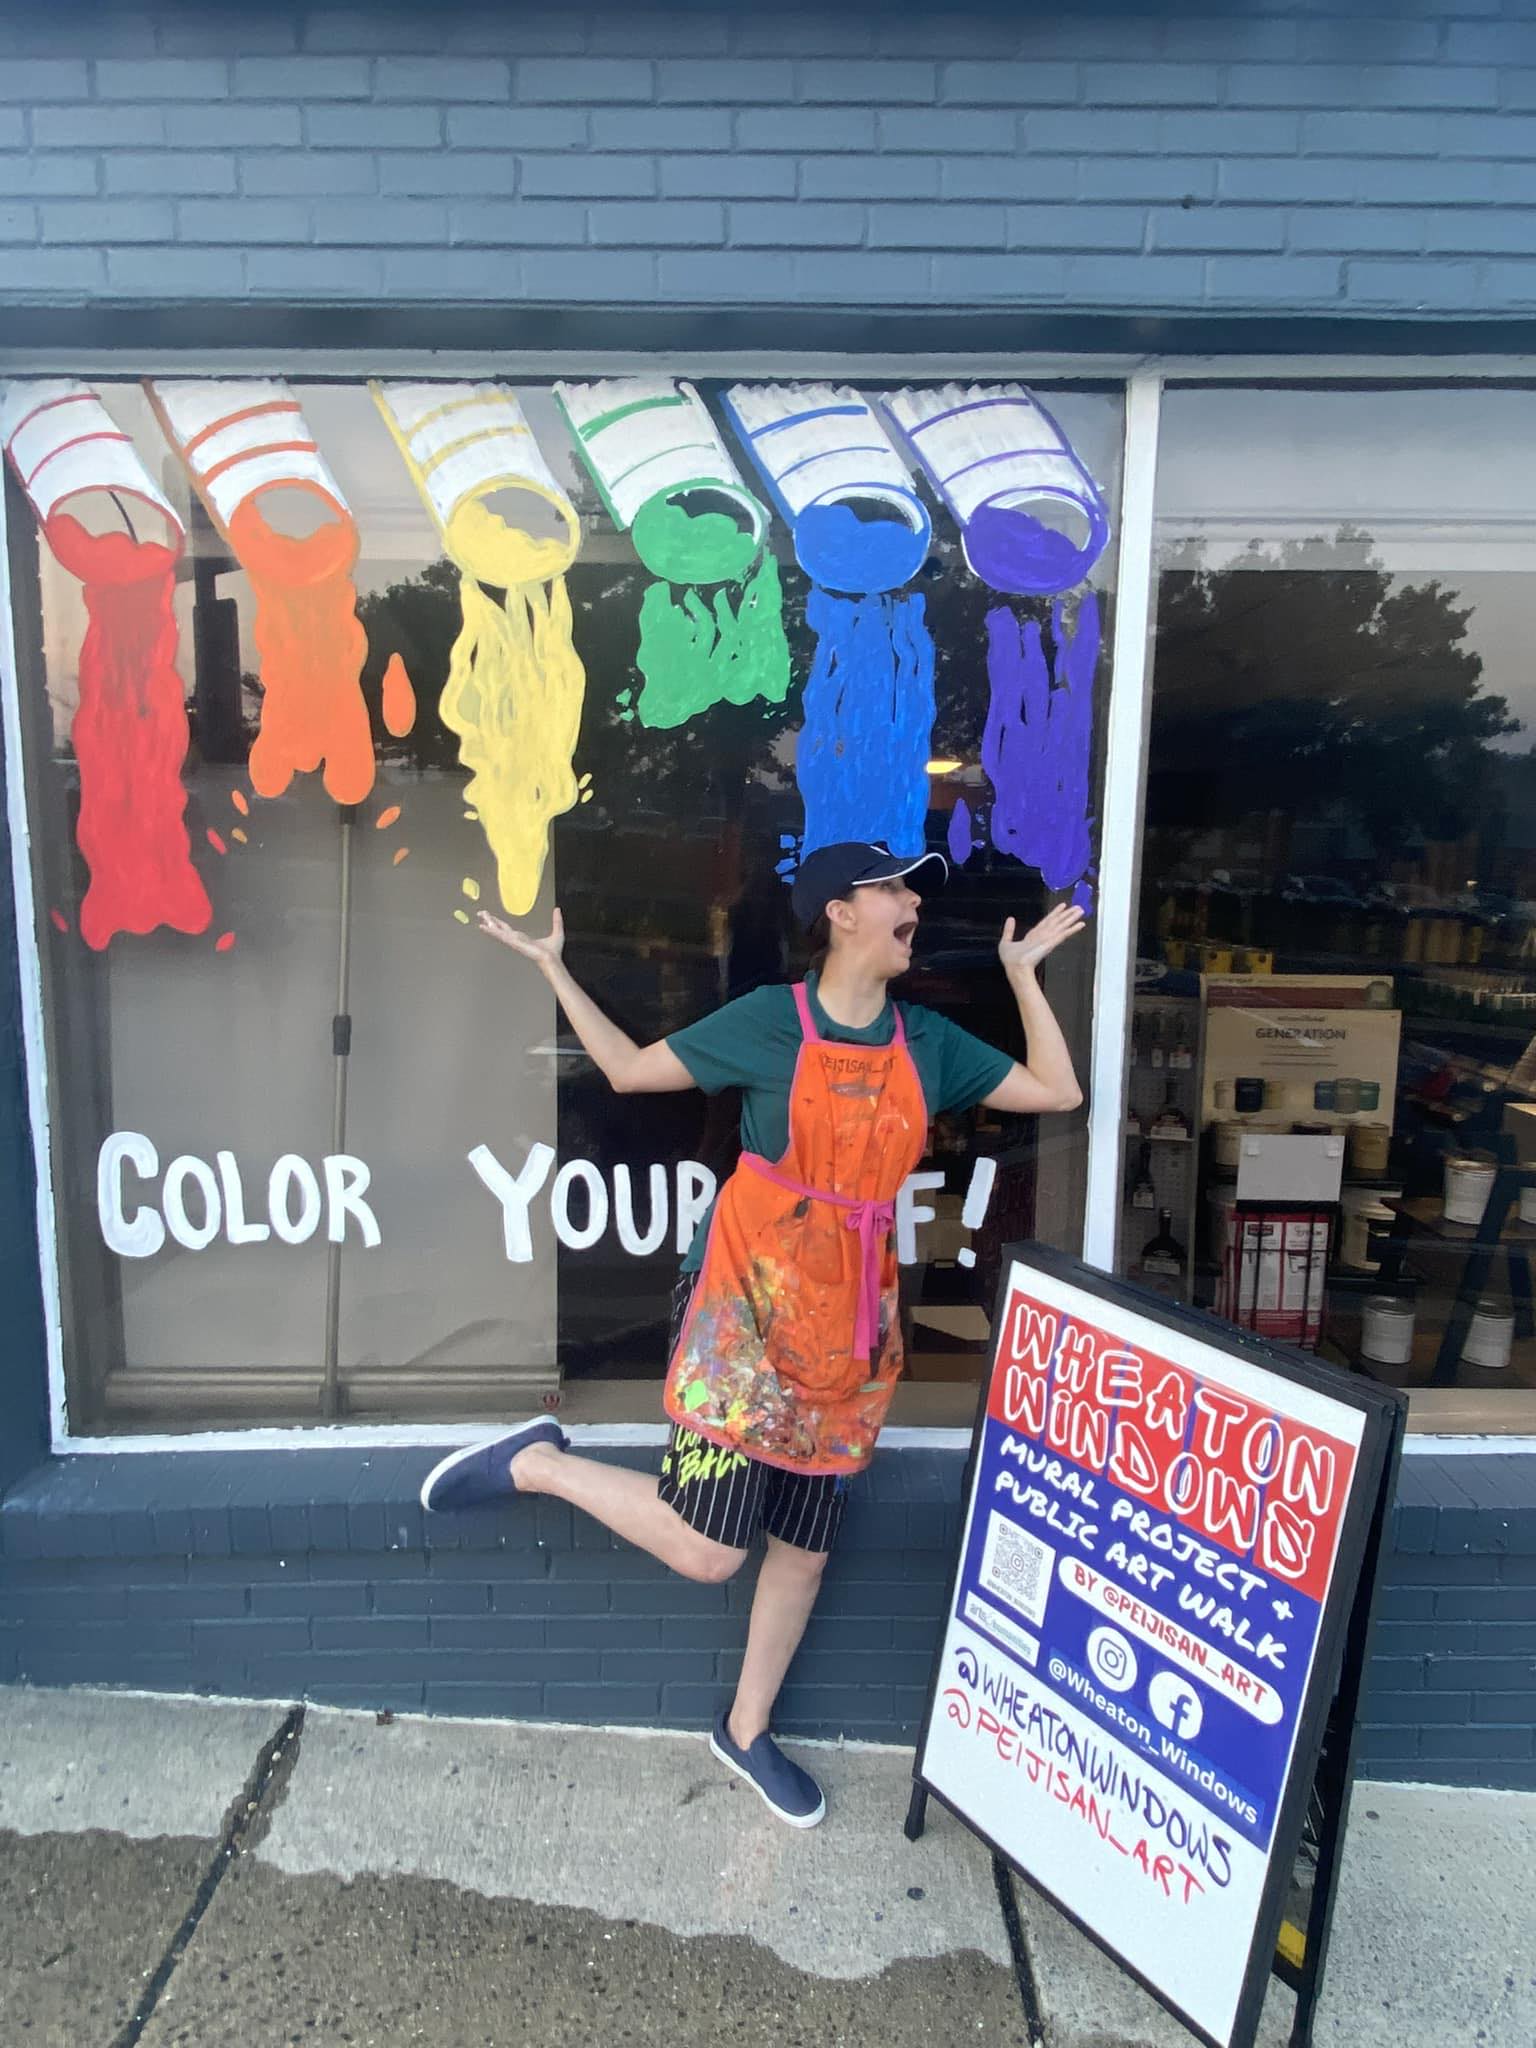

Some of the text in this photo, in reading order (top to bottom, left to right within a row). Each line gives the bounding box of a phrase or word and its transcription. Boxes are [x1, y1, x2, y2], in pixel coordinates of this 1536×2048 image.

[98, 1131, 381, 1258] COLOR
[1012, 1303, 1336, 1516] WHEATON
[994, 1470, 1287, 1670] PUBLIC ART WALK
[1000, 1434, 1099, 1509] MURAL
[1110, 1498, 1268, 1600] PROJECT
[1073, 1563, 1098, 1591] BY
[1102, 1586, 1268, 1705] @PEIJISAN_ART
[943, 1687, 1206, 1904] @PEIJISAN_ART
[955, 1646, 1232, 1888] @WHEATONWINDOWS
[1048, 1657, 1257, 1824] @Wheaton_Windows
